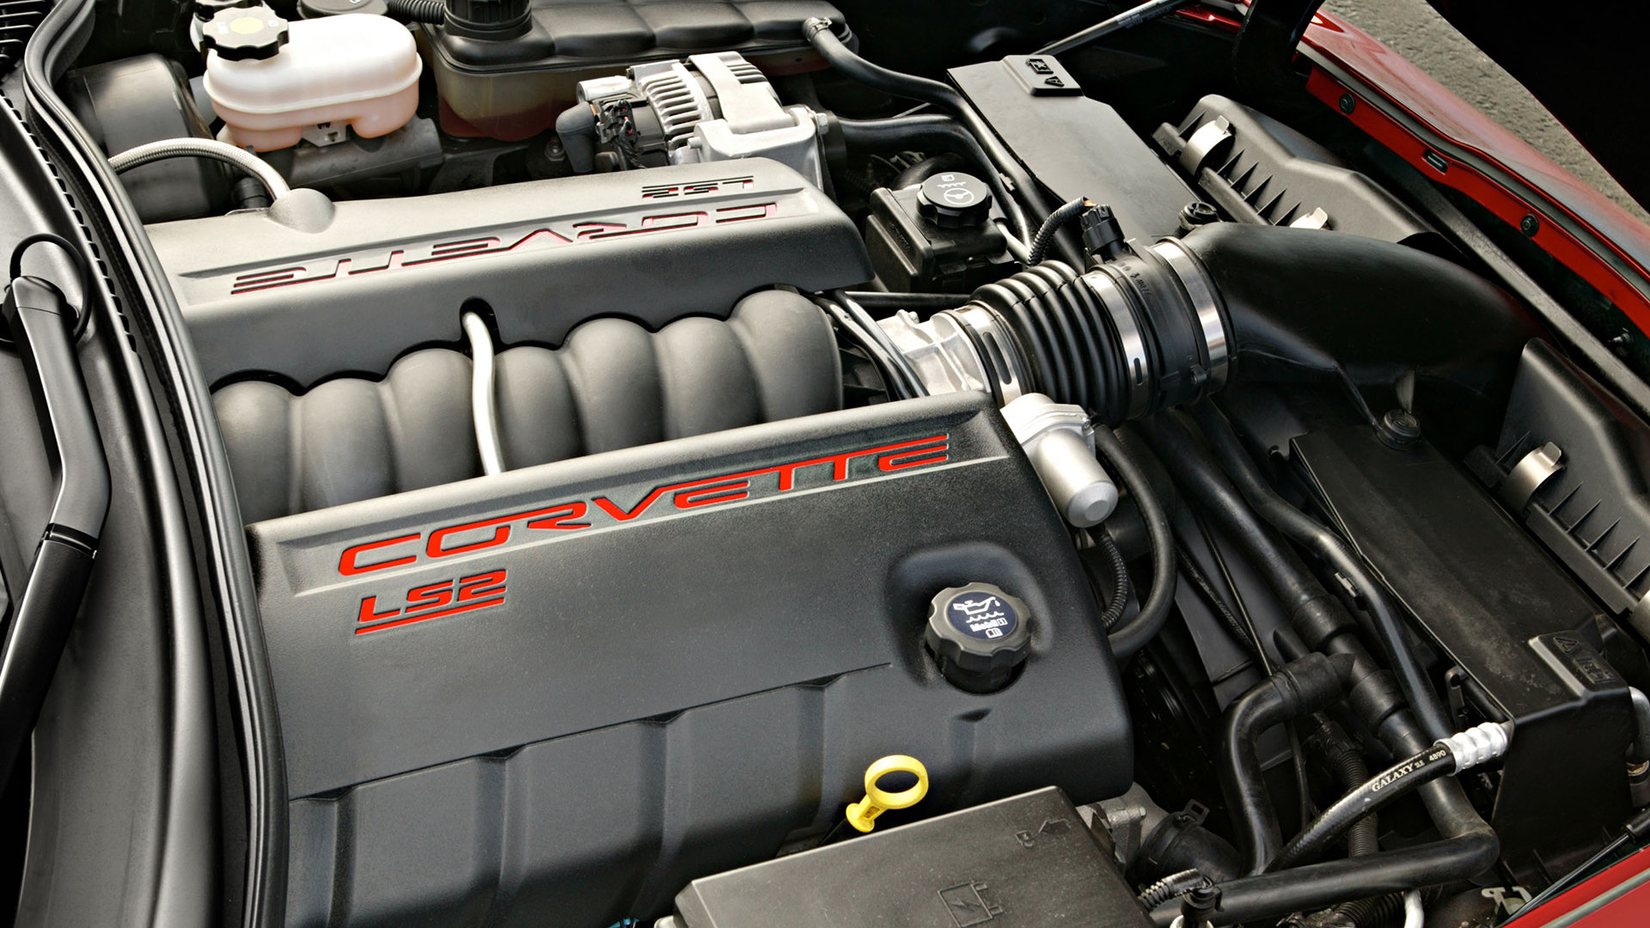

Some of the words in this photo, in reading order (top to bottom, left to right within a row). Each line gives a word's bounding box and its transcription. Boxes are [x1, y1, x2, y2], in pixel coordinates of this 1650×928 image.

[641, 176, 754, 199] LS2
[231, 202, 777, 295] CORVETTE
[339, 434, 949, 576] CORVETTE
[357, 570, 507, 623] LS2
[1372, 764, 1414, 792] GALAXY
